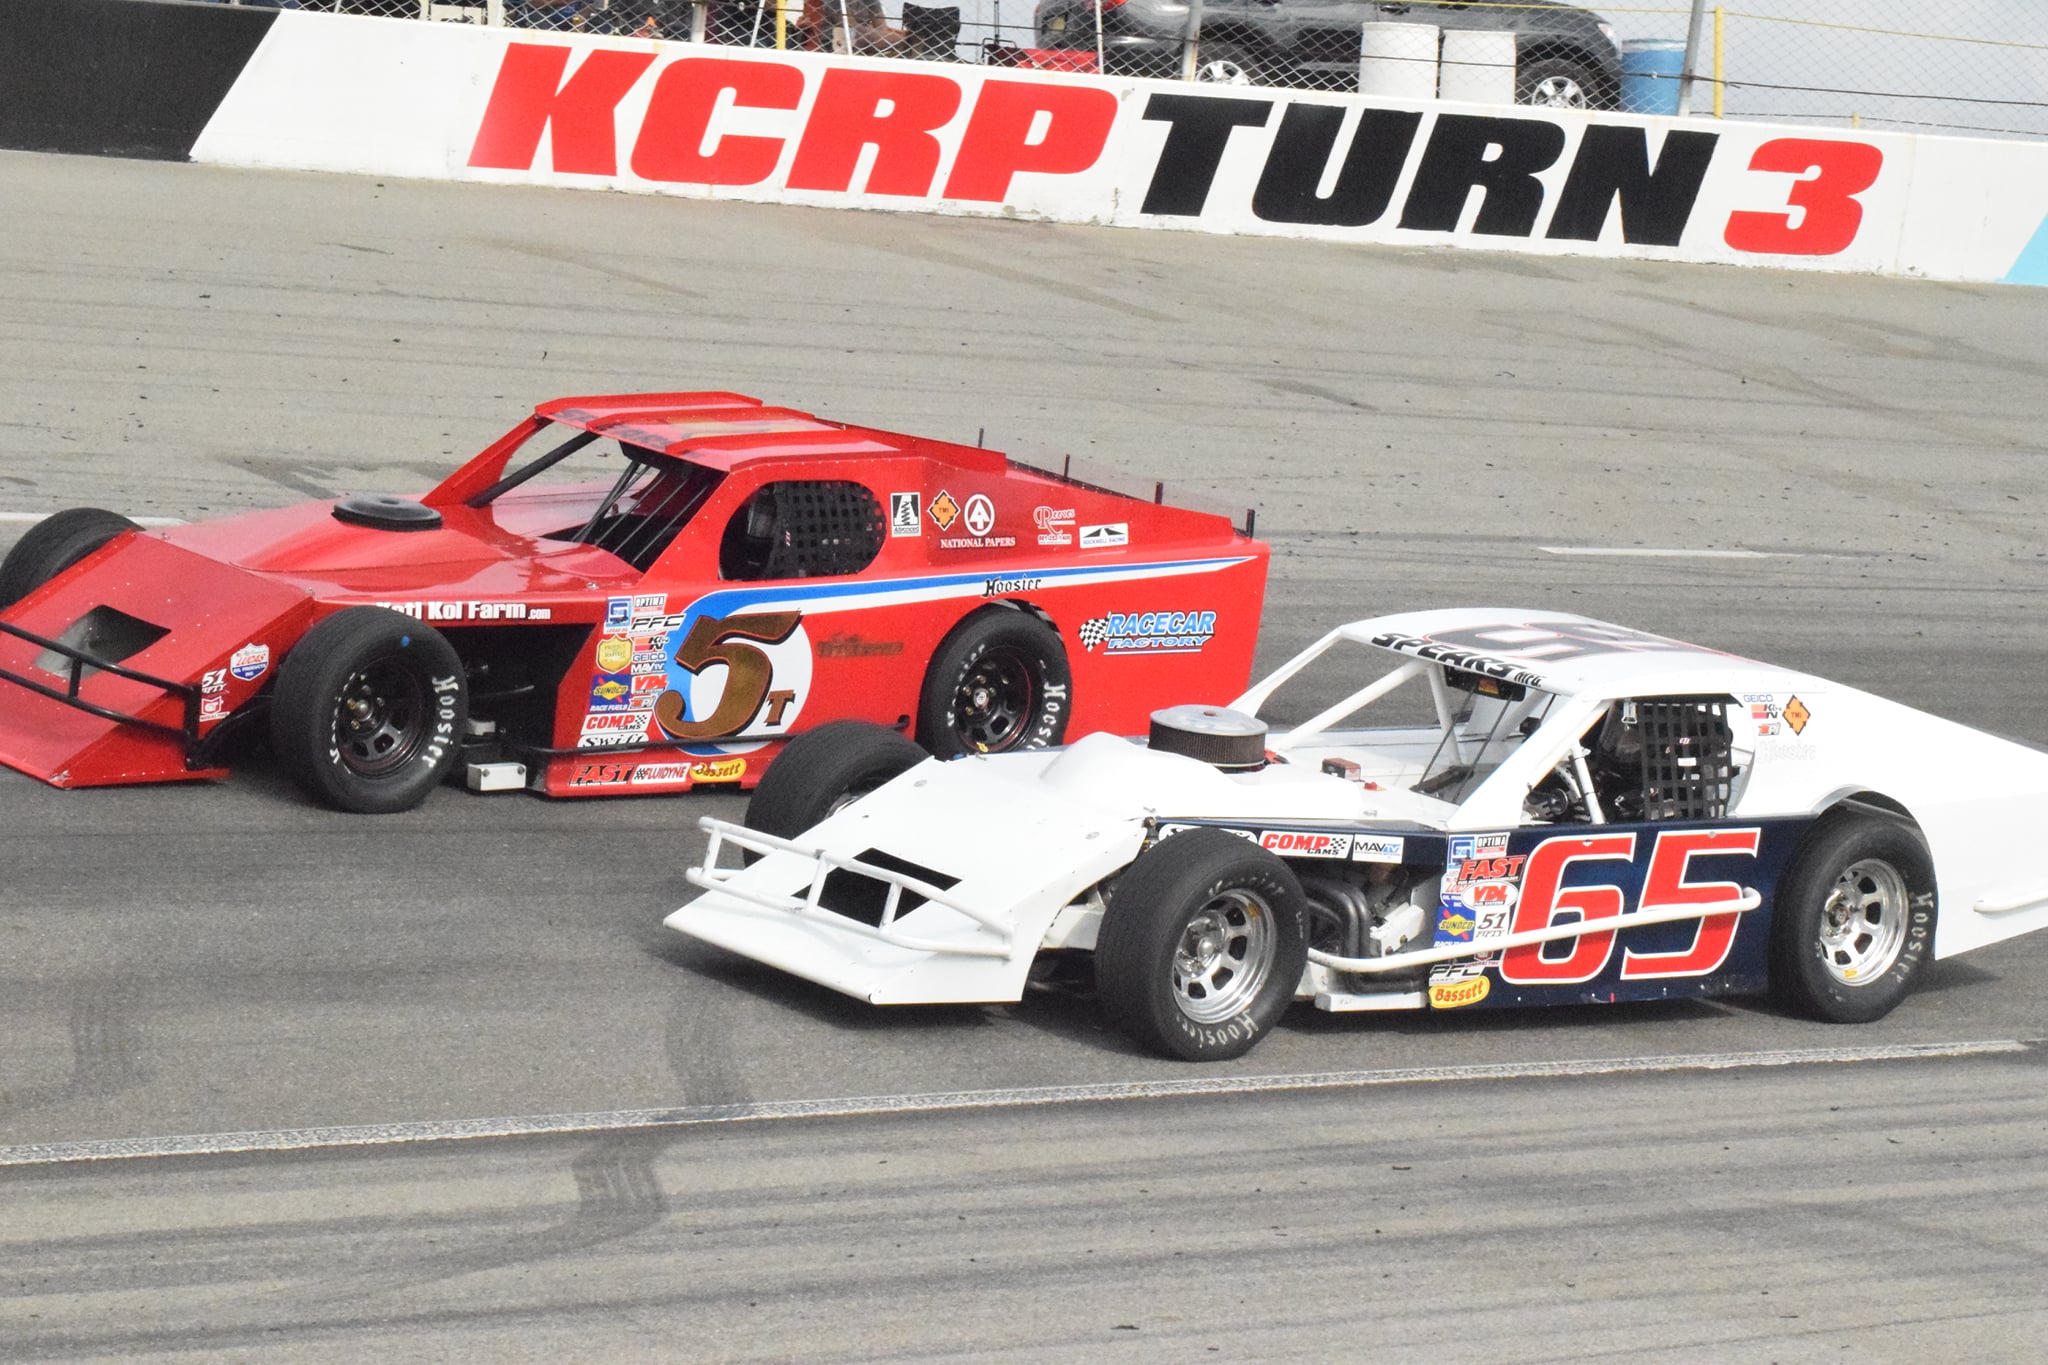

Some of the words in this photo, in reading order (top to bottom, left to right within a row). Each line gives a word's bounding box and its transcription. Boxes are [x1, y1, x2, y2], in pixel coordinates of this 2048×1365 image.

[467, 42, 1118, 203] KCRP
[1141, 93, 1721, 248] TURN
[1724, 137, 1884, 256] 3
[940, 538, 983, 548] NATIONAL
[985, 537, 1016, 547] PAPERS
[981, 575, 1041, 597] Hoosier
[635, 596, 665, 608] OPTIMA
[631, 615, 684, 630] PFC
[1107, 611, 1216, 636] RACECAR
[1108, 635, 1212, 648] FACTORY
[633, 653, 666, 662] GEICO
[1371, 633, 1529, 678] SPEARS
[202, 668, 227, 688] 51
[594, 686, 628, 696] SUNOCO
[1743, 694, 1774, 703] GEICO
[586, 715, 635, 729] COMP
[570, 766, 633, 783] FAST
[643, 767, 686, 780] FLUIDYNE
[1262, 833, 1330, 851] COMP
[1354, 841, 1400, 854] MAVTV
[1477, 835, 1507, 847] OPTIMA
[1307, 848, 1340, 856] CAMS
[1459, 856, 1524, 881] FAST
[1499, 827, 1761, 985] 65
[1440, 921, 1475, 929] SUNOCO
[1477, 912, 1507, 930] 51
[1435, 980, 1484, 1002] Bassett
